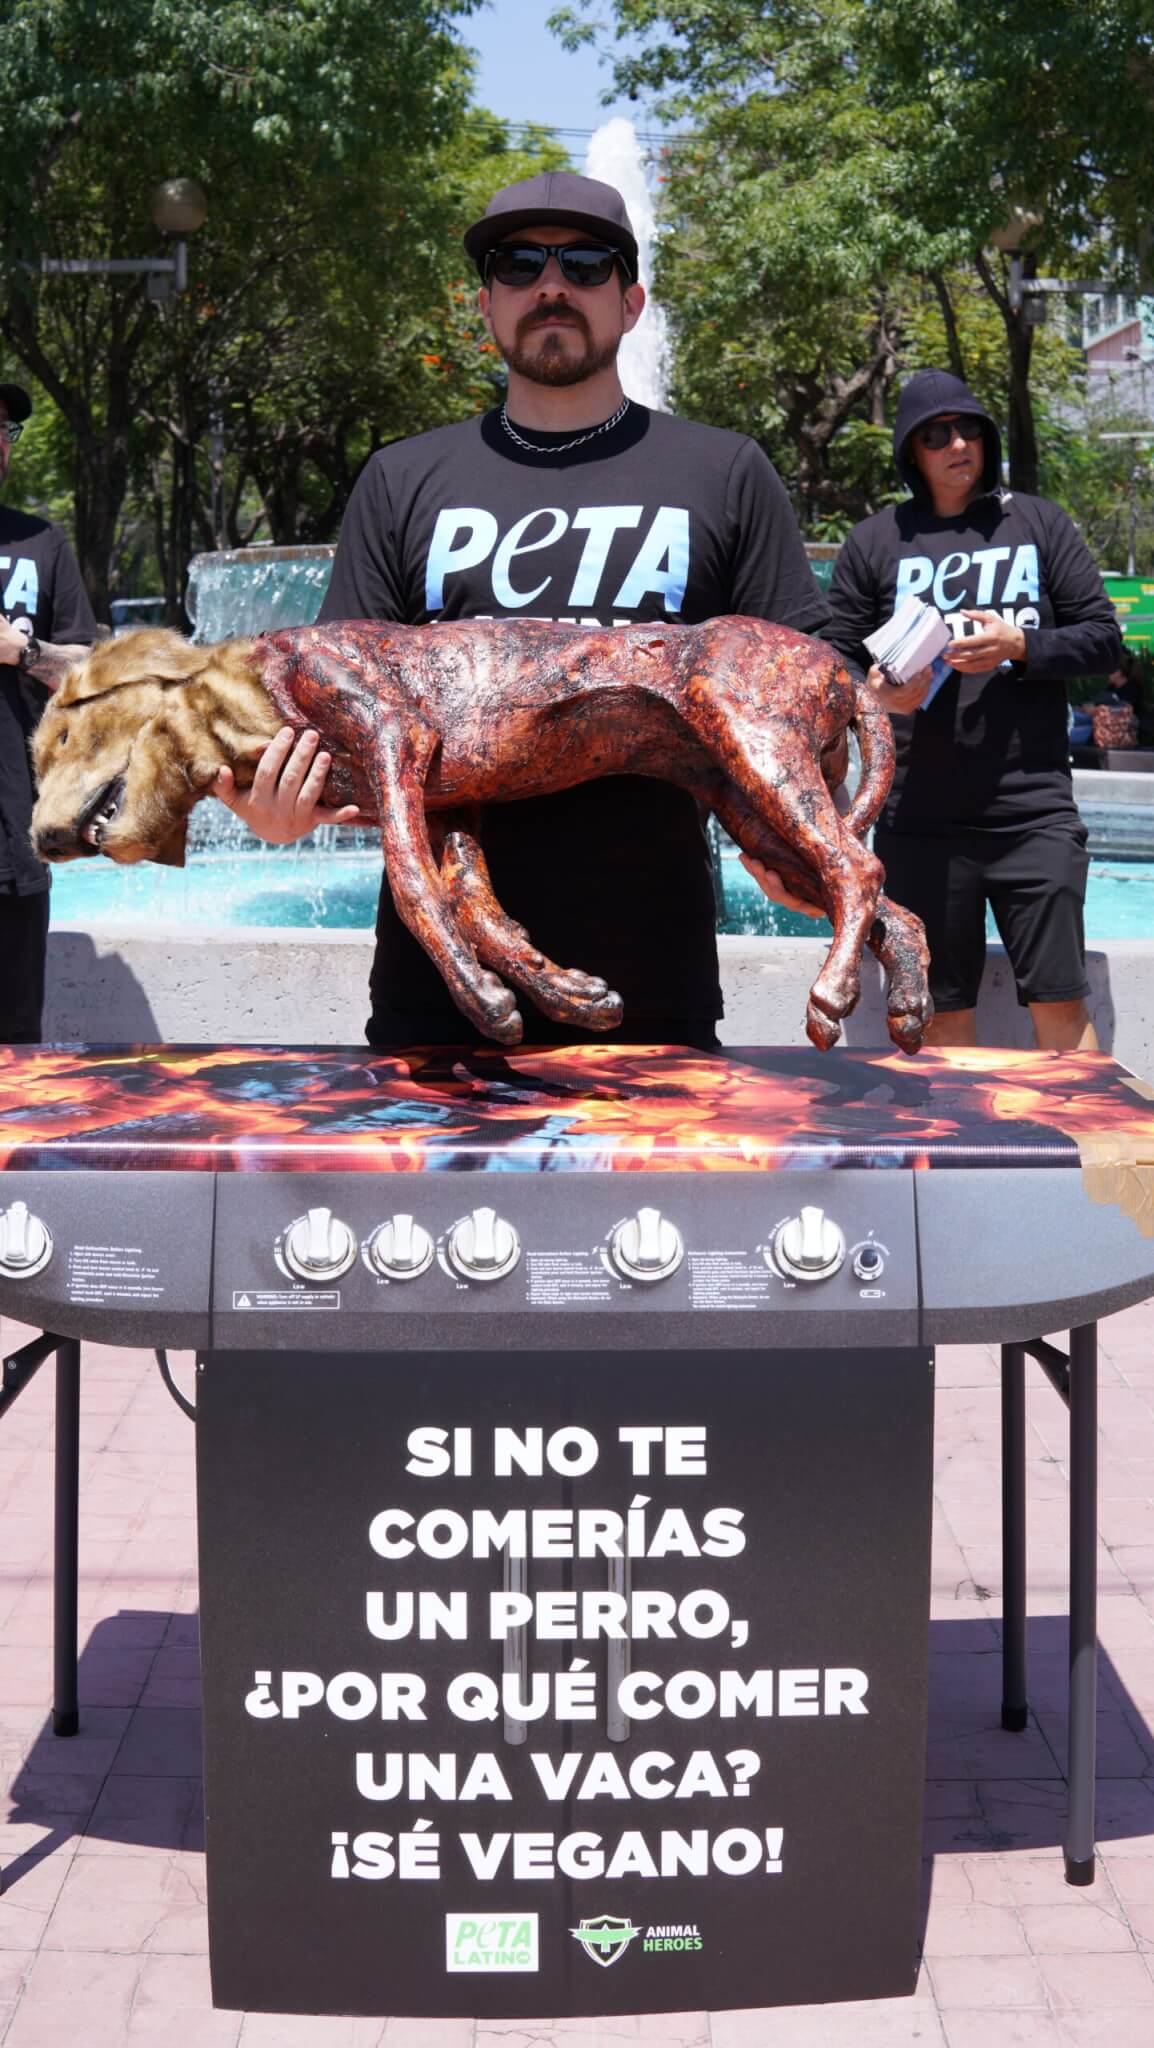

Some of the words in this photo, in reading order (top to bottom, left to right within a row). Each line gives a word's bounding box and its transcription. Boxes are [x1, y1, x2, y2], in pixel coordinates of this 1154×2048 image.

[406, 1427, 471, 1476] SI
[495, 1427, 598, 1476] NO
[619, 1427, 706, 1475] TE
[369, 1494, 745, 1559] COMERÍAS
[366, 1592, 467, 1640] UN
[490, 1590, 748, 1648] PERRO,
[245, 1671, 427, 1720] ¿POR
[447, 1658, 598, 1721] QUÉ
[617, 1668, 868, 1720] COMER
[356, 1752, 512, 1800] UNA
[531, 1750, 760, 1800] VACA?
[332, 1819, 440, 1879] ¡SÉ
[459, 1828, 783, 1879] VEGANO!
[643, 1937, 704, 1952] HEROES
[646, 1925, 701, 1938] ANIMAL
[453, 1950, 530, 1966] LATINO
